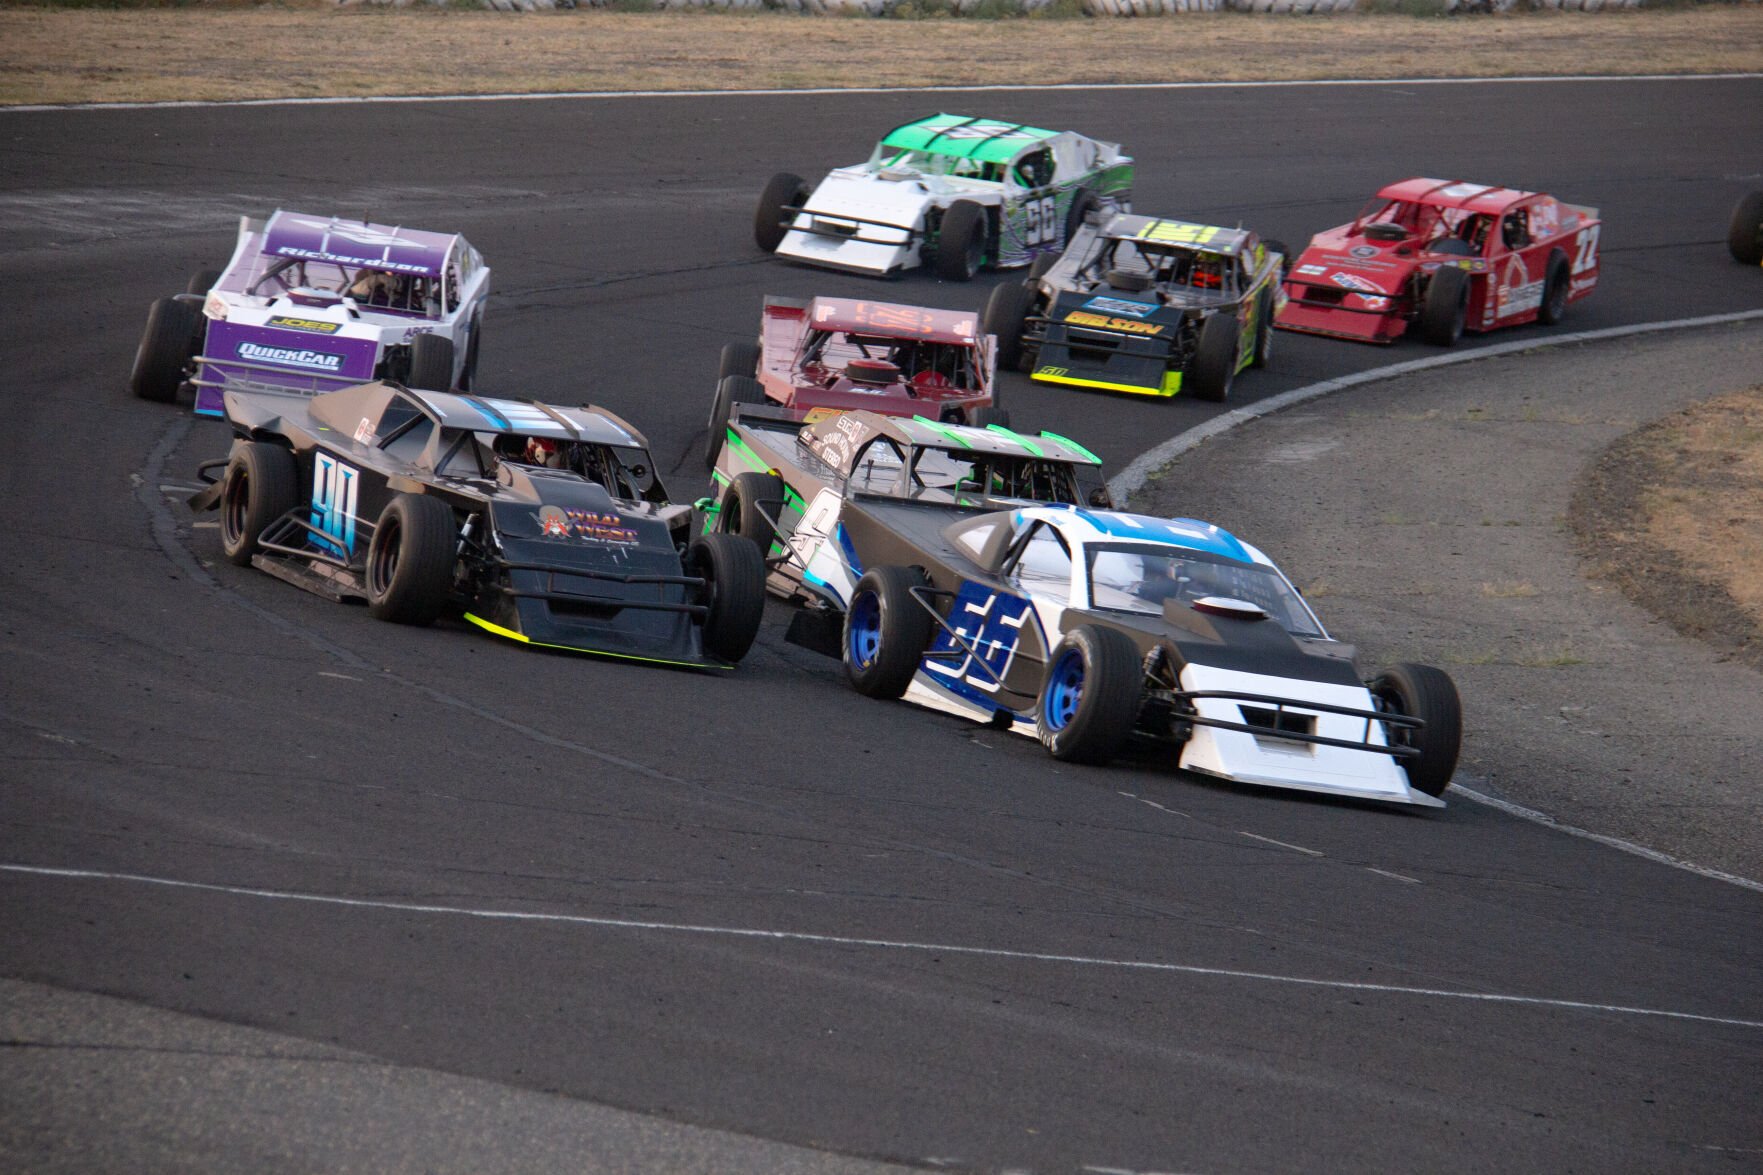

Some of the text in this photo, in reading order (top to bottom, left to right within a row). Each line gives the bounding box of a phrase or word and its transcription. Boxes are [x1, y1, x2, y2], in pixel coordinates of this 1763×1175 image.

[277, 246, 430, 274] Richardson
[271, 317, 337, 331] JOES
[576, 520, 640, 542] WEST
